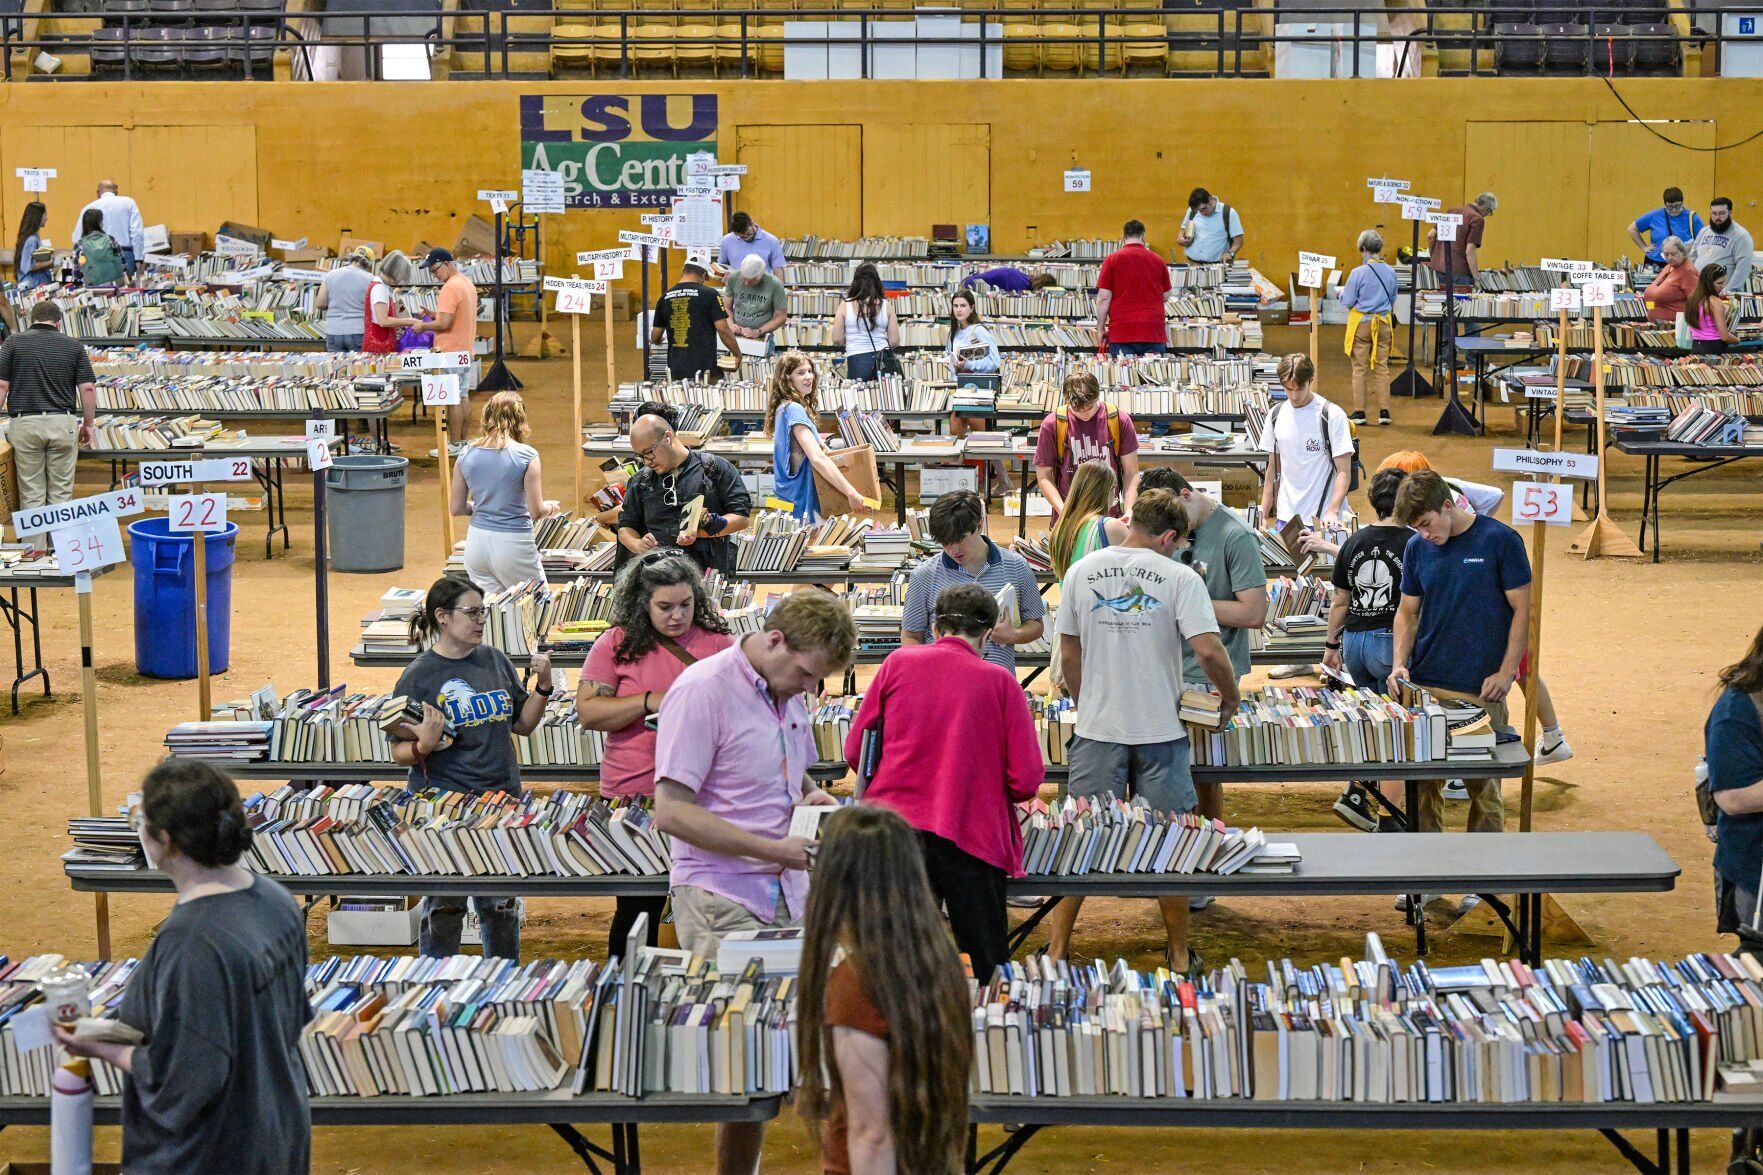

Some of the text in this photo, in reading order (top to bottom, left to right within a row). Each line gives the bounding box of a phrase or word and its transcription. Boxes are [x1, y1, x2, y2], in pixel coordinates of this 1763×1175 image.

[520, 95, 717, 141] LSU
[530, 143, 688, 197] AgCent
[695, 163, 707, 172] 29
[1072, 180, 1083, 188] 59
[611, 194, 620, 204] &
[1379, 189, 1393, 201] 32
[1407, 206, 1423, 218] 59
[649, 215, 674, 223] HISTORY
[657, 227, 672, 237] 28
[1440, 225, 1451, 236] 33
[620, 233, 640, 241] MILITARY
[640, 235, 660, 244] HISTORY
[578, 253, 601, 262] MILITARY
[601, 251, 622, 260] HISTORY
[600, 263, 615, 276] 27
[1302, 269, 1318, 284] 25
[545, 280, 605, 290] HIDDEN TREASRES 24
[747, 293, 768, 303] ARMY
[1557, 291, 1572, 305] 33
[1587, 286, 1604, 302] 36
[564, 295, 585, 310] 24
[403, 354, 469, 368] ART 26
[427, 383, 448, 401] 26
[1531, 388, 1558, 396] VINTAG
[317, 443, 328, 462] 2
[1566, 460, 1576, 468] 53
[143, 462, 248, 480] SOUTH 22
[383, 469, 405, 479] BRUTE
[1520, 487, 1558, 518] 53
[20, 500, 110, 530] LOUISIANA
[117, 494, 137, 509] 34
[178, 498, 217, 527] 22
[68, 535, 104, 566] 34
[1087, 567, 1166, 584] SALTY CREW
